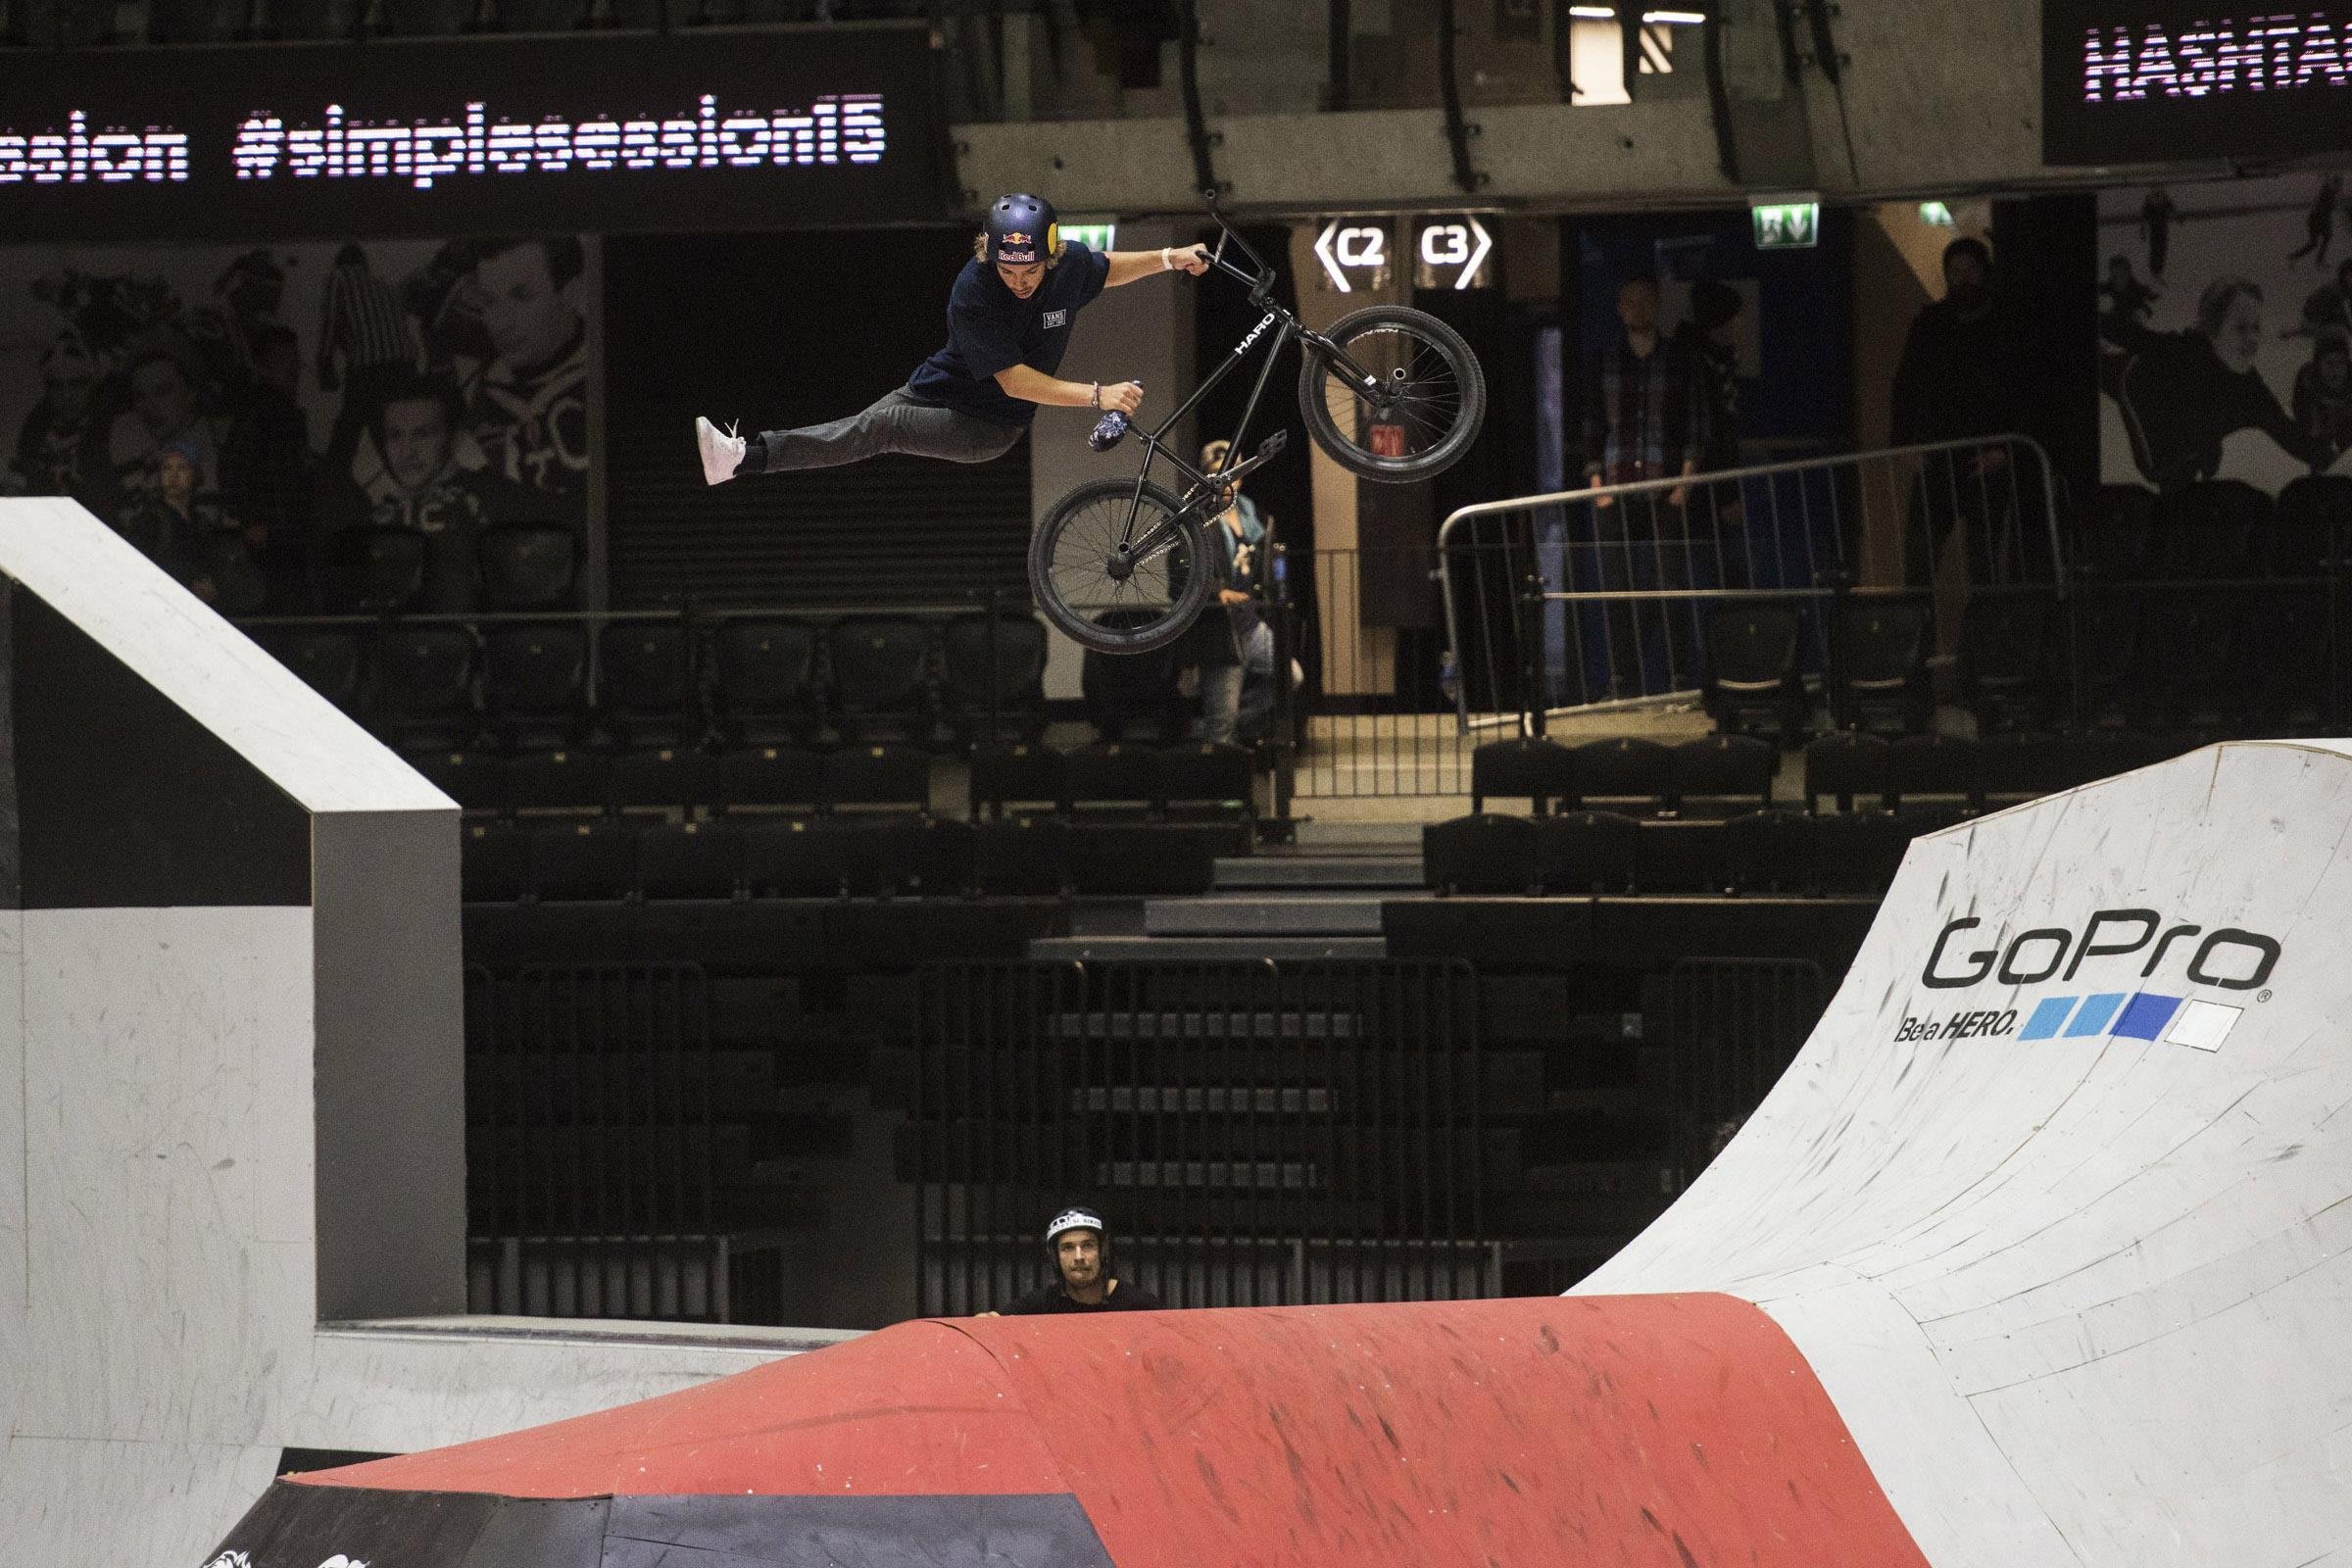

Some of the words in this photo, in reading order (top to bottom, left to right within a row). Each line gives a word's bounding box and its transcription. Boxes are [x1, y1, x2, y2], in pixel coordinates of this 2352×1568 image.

[2084, 13, 2352, 102] HASHTA
[232, 93, 887, 188] #simplesession15
[999, 250, 1018, 262] Red
[1018, 251, 1035, 262] Bull
[1337, 227, 1385, 267] C2
[1421, 224, 1468, 265] C3
[1047, 312, 1064, 320] VANS
[1234, 313, 1275, 355] HARO
[1922, 908, 2281, 990] GoPro
[1894, 1017, 1925, 1042] Be
[1923, 1022, 1940, 1041] a
